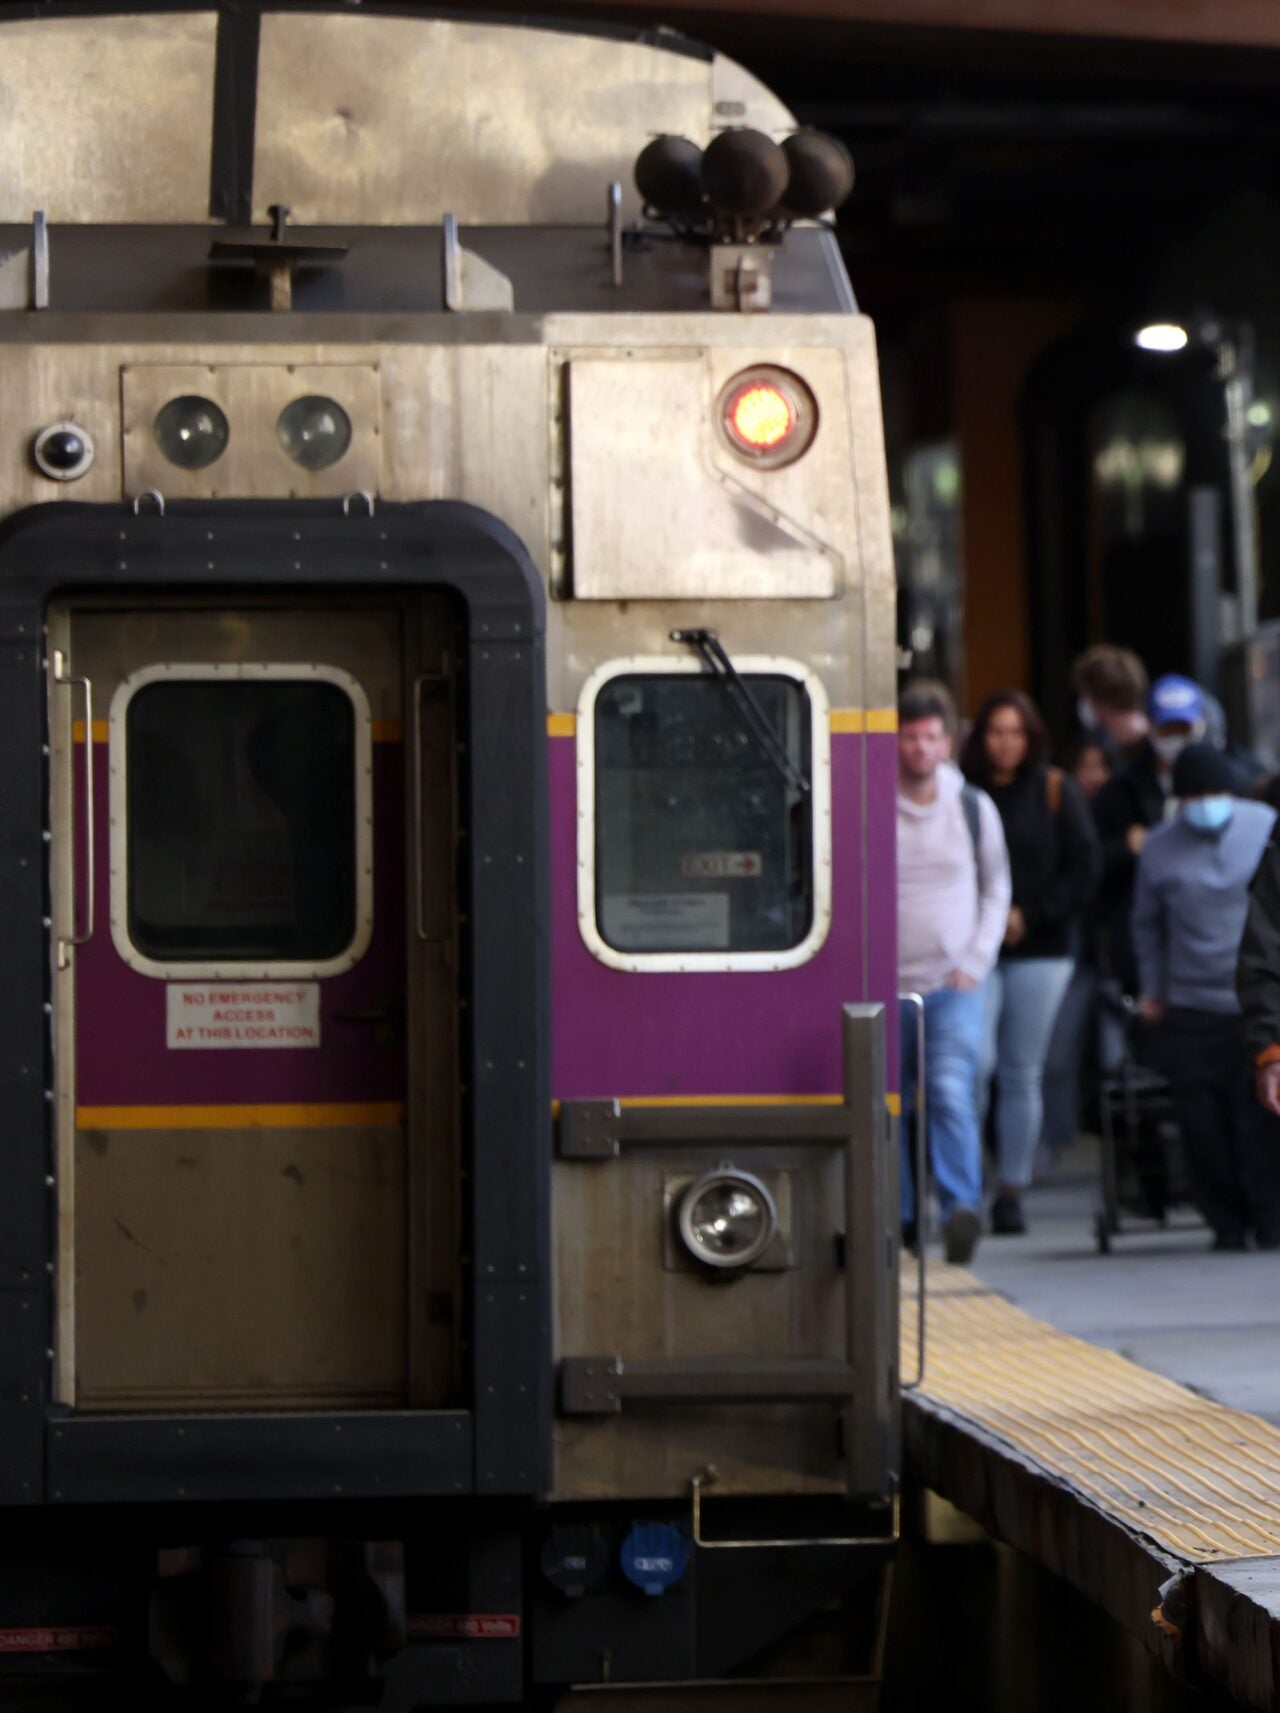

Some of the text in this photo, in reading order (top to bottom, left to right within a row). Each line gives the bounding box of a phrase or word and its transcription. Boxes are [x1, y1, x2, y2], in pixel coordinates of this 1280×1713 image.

[182, 990, 306, 1005] NO EMERGENCY
[213, 1009, 276, 1022] ACCESS
[176, 1026, 313, 1040] AT THIS LOCATION
